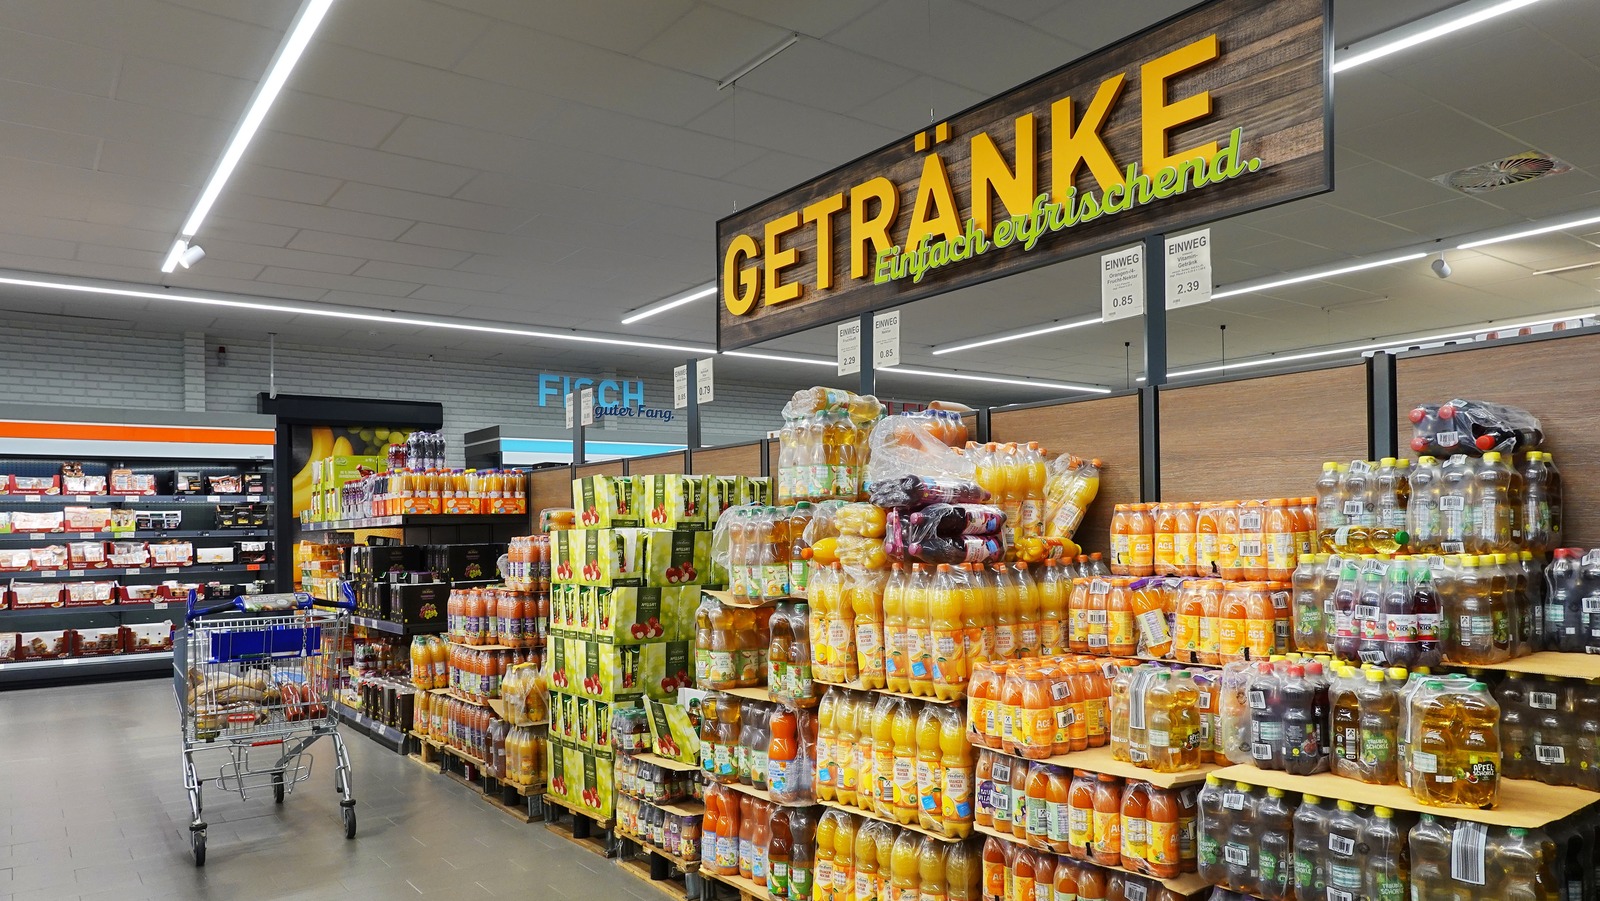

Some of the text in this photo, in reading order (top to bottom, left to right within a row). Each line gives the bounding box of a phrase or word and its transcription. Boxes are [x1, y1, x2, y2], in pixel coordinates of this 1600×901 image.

[723, 33, 1221, 317] GETRÄNKE
[874, 126, 1263, 286] Einfach erfrischend.
[1168, 236, 1207, 256] EINWEG
[1105, 253, 1140, 271] EINWEG
[1177, 254, 1198, 262] Vitamin-
[1177, 280, 1200, 295] 2.39
[1112, 295, 1133, 308] 0.85
[875, 316, 898, 329] EINWEG
[840, 325, 860, 338] EINWEG
[879, 348, 894, 359] 0.85
[843, 356, 856, 366] 2.29
[698, 385, 711, 396] 0.79
[594, 404, 675, 423] guter Fang.
[1135, 543, 1150, 551] ACE
[1157, 541, 1173, 550] ACE
[1220, 629, 1236, 638] ACE
[1247, 630, 1265, 639] ACE
[1036, 719, 1051, 729] ACE
